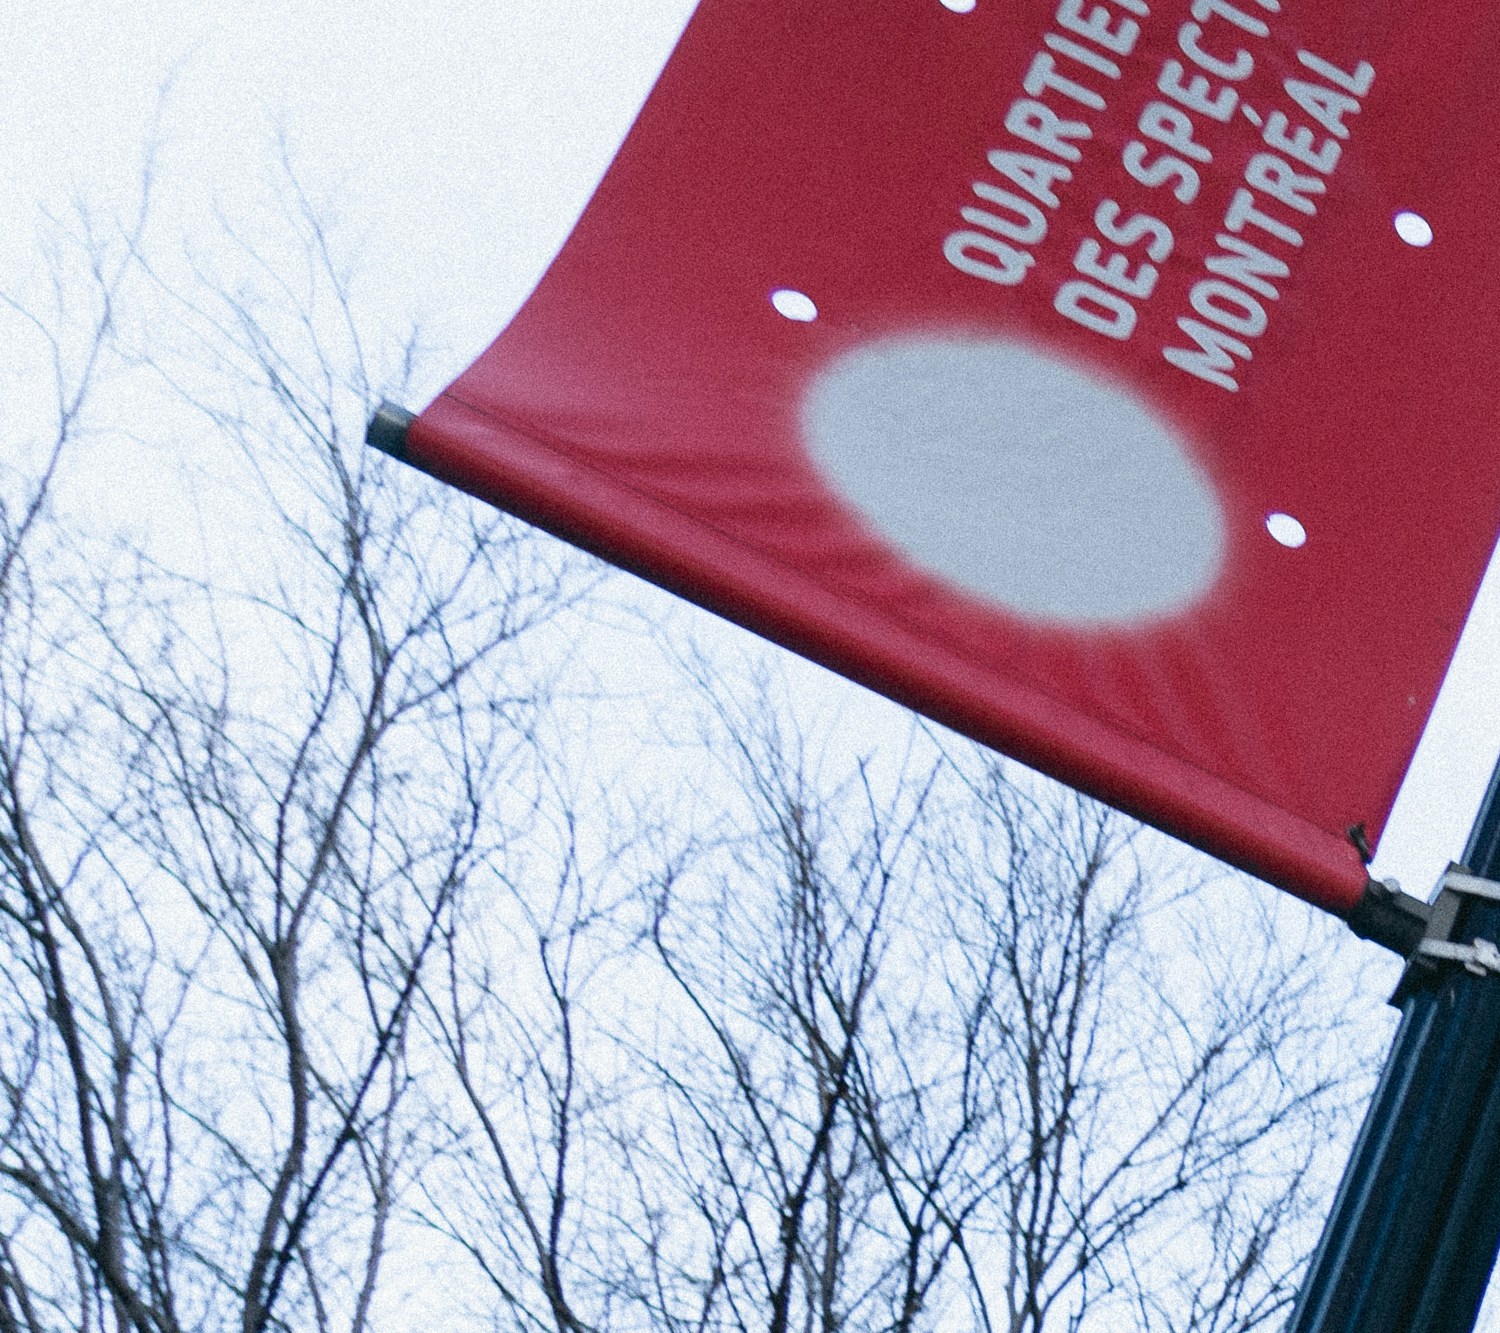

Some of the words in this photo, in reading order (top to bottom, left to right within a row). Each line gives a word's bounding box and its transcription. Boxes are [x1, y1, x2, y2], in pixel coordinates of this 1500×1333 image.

[942, 0, 1150, 286] QUARTIE
[1054, 200, 1175, 341] DES
[1121, 0, 1281, 204] SPECT
[1162, 48, 1377, 392] MONTRÉAL
